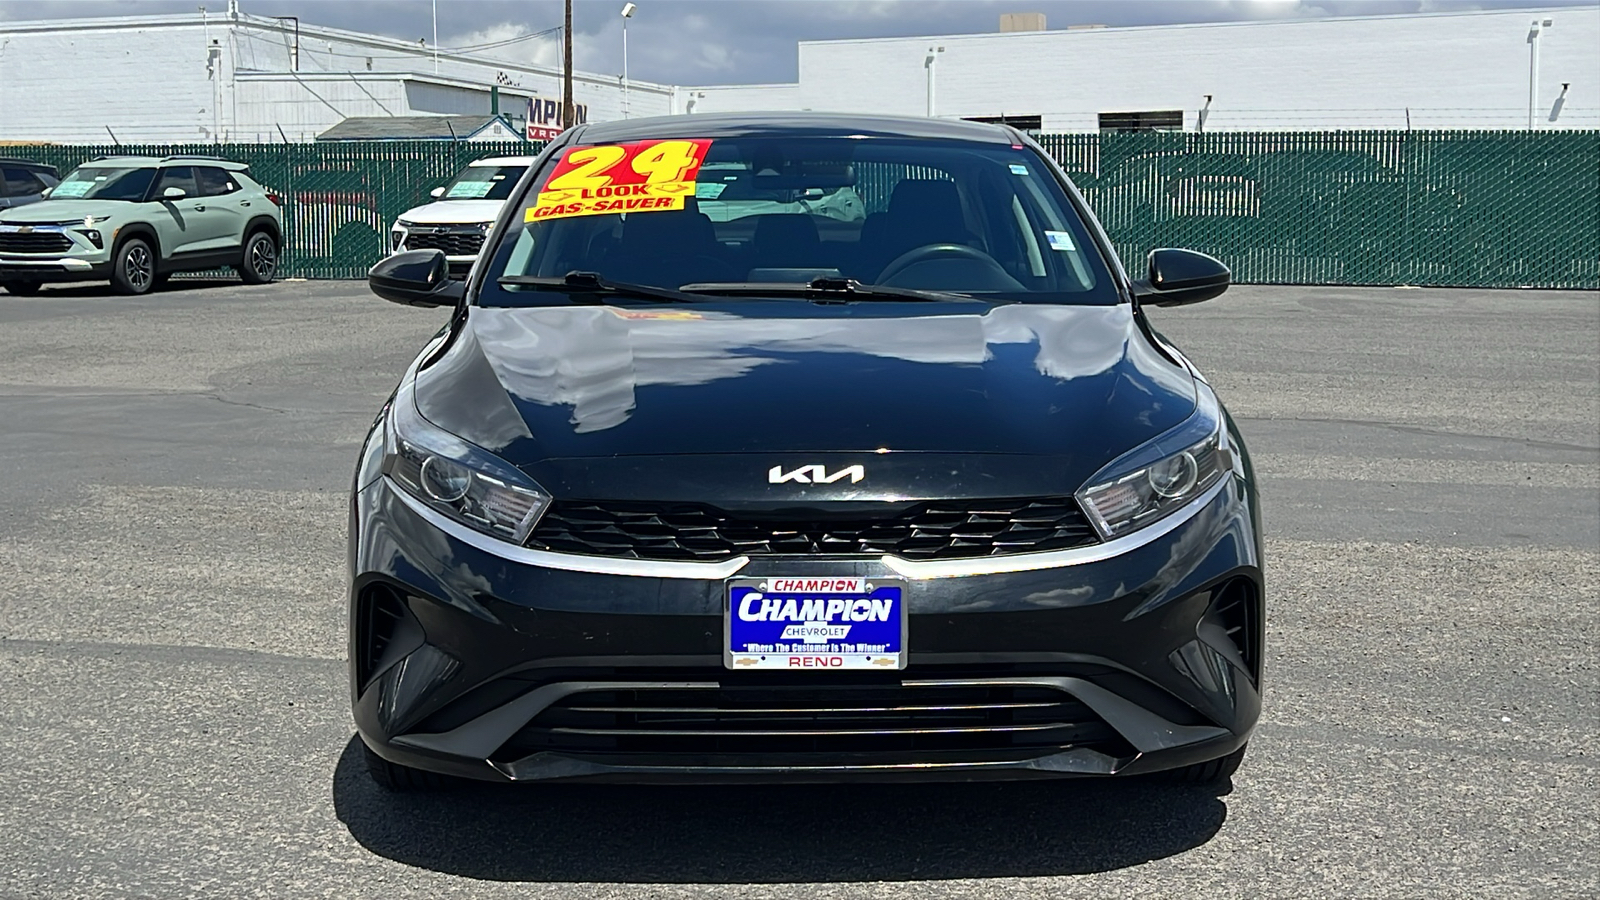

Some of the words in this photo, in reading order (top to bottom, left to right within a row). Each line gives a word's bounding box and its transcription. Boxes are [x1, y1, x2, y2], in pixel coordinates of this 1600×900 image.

[528, 98, 587, 126] MPIN
[548, 141, 699, 190] 24
[581, 185, 650, 199] LOOK
[533, 197, 675, 218] GAS-SAVER
[774, 580, 858, 592] CHAMPION
[738, 592, 893, 622] CHAMPION
[785, 627, 846, 636] CHEVROLET
[775, 643, 790, 653] The
[791, 643, 830, 653] Customer
[840, 643, 855, 653] The
[788, 656, 843, 667] RENO
